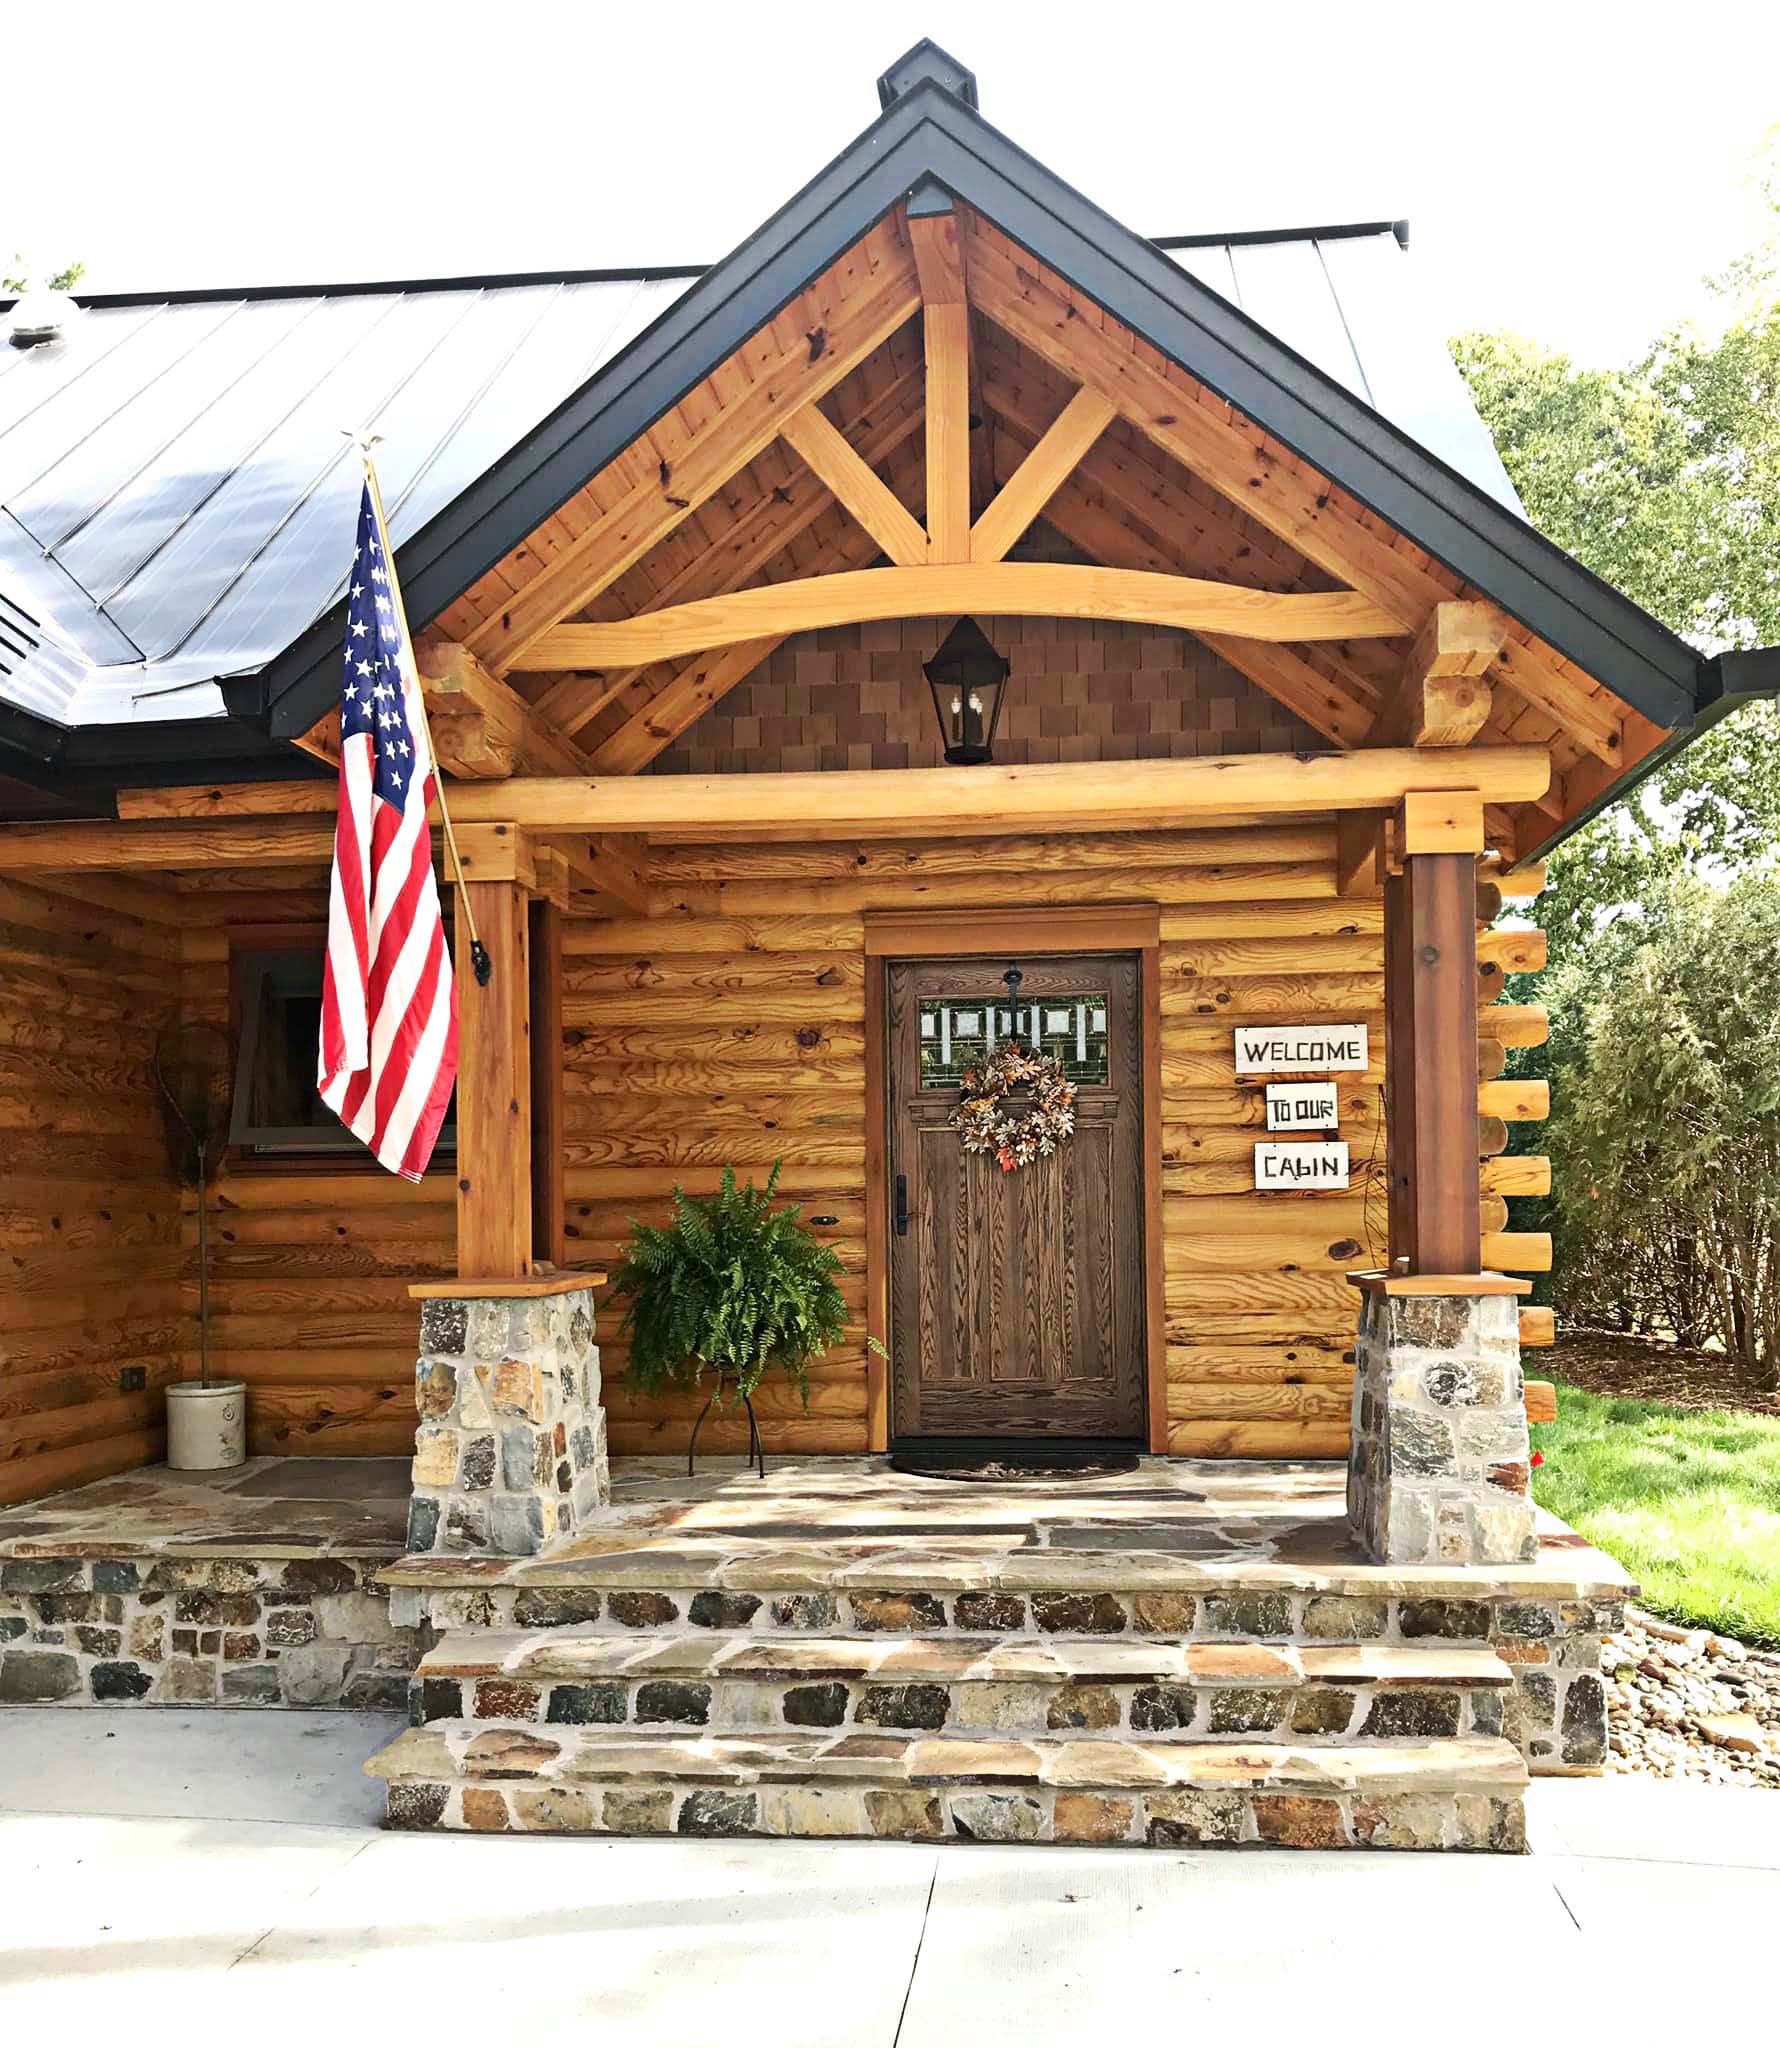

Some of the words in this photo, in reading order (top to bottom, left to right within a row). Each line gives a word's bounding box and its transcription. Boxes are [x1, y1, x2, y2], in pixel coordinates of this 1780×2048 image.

[1244, 1041, 1361, 1062] WELCOME
[1267, 1099, 1291, 1122] TO
[1295, 1100, 1333, 1120] OUR
